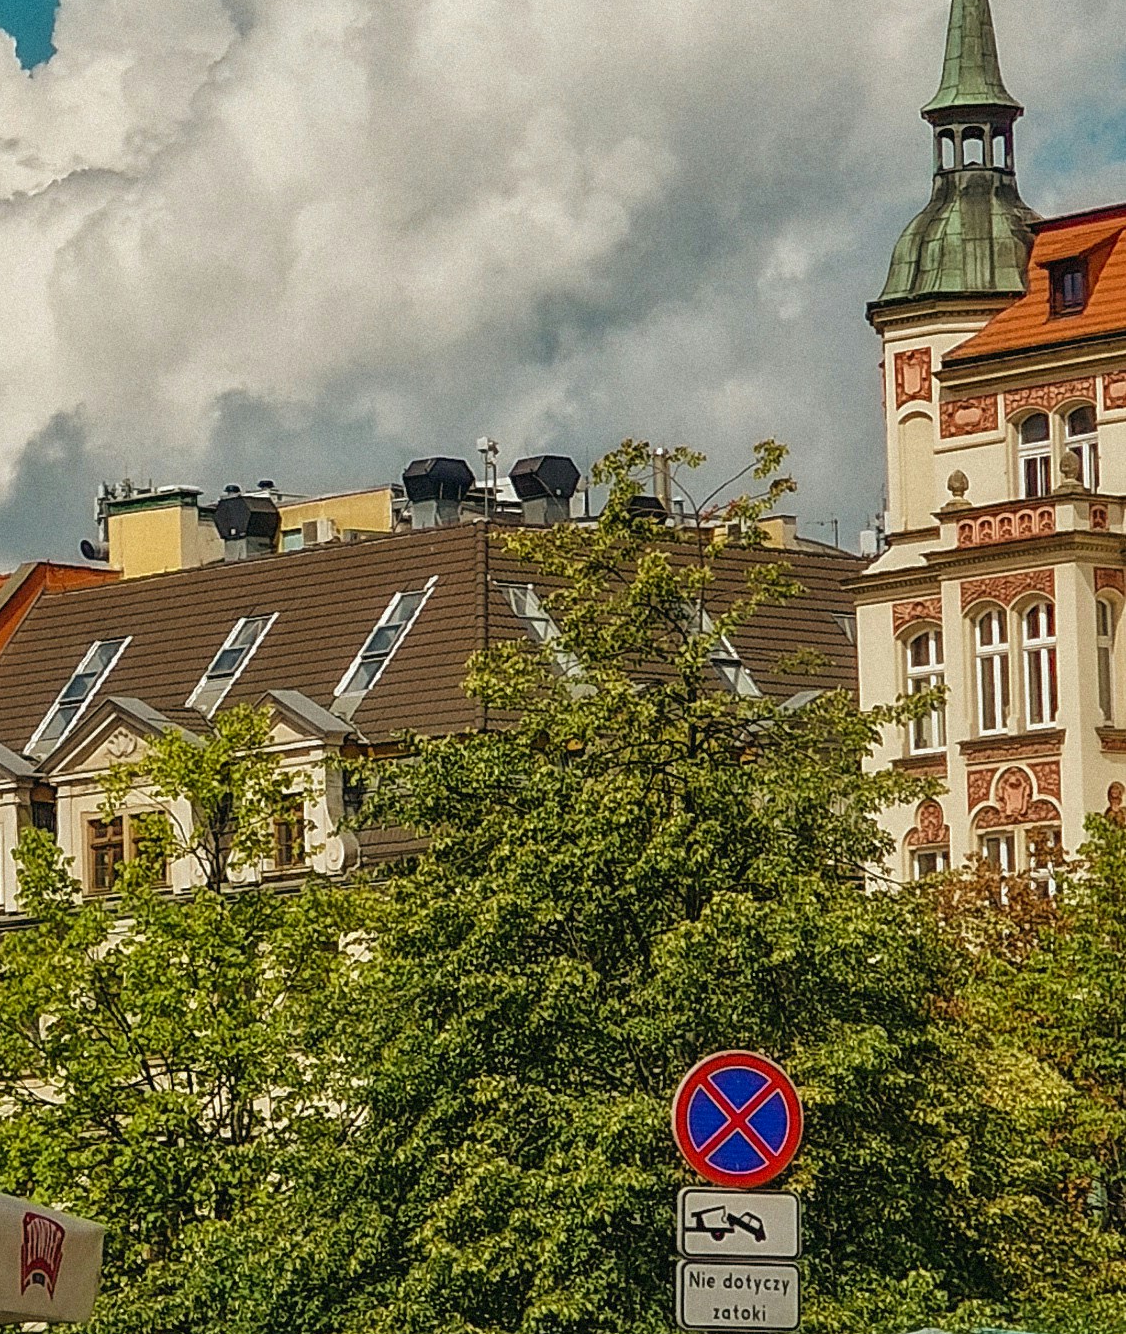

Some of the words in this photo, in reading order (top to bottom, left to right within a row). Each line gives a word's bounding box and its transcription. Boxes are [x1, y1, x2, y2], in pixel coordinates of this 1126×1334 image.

[690, 1271, 716, 1288] Nie
[723, 1272, 790, 1296] dotyczy
[712, 1305, 767, 1322] zatoki
